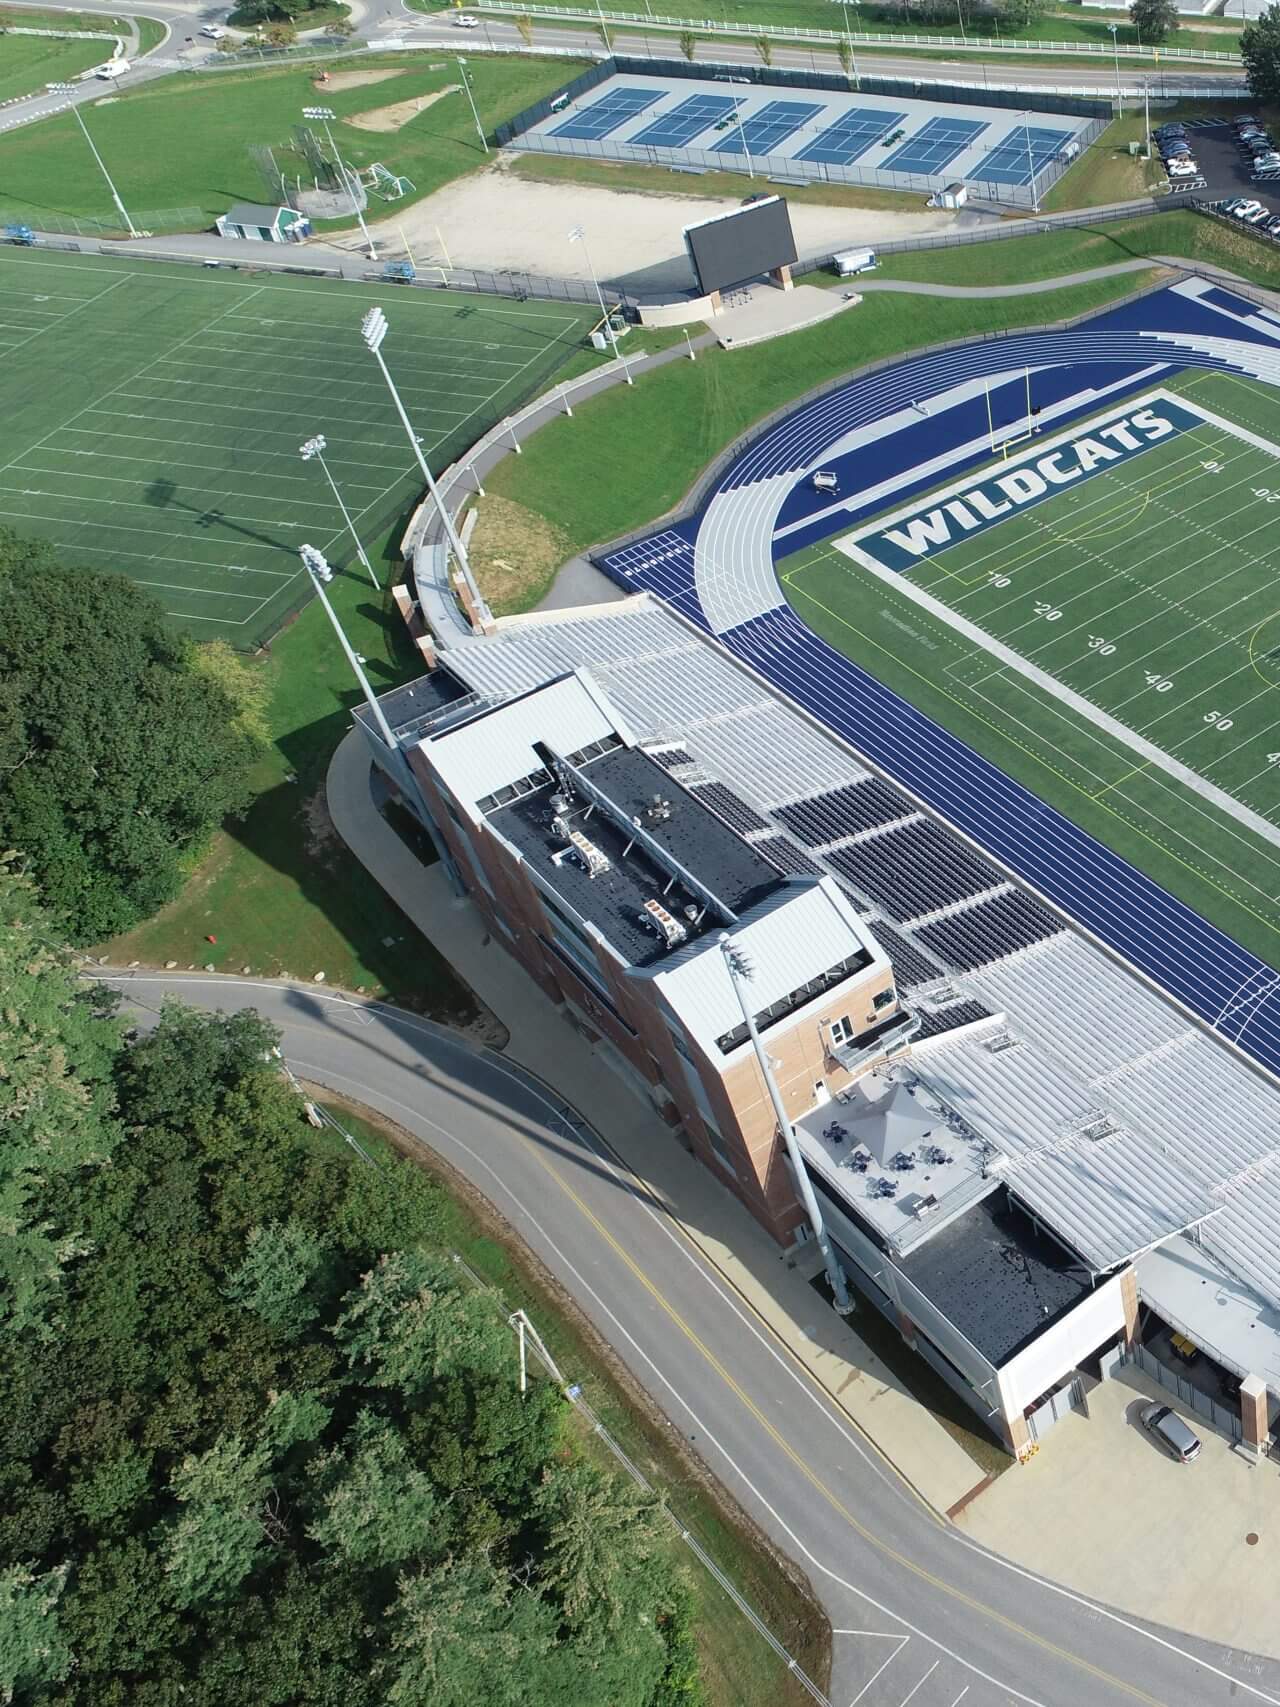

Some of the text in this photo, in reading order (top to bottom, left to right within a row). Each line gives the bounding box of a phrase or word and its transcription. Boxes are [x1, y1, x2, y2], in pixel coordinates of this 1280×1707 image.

[1202, 460, 1225, 475] 10
[882, 409, 1174, 556] WILDCATS
[987, 572, 1012, 588] 10
[1033, 602, 1063, 621] 20
[1088, 636, 1117, 656] 30
[1145, 673, 1174, 692] 40
[1203, 710, 1234, 731] 50
